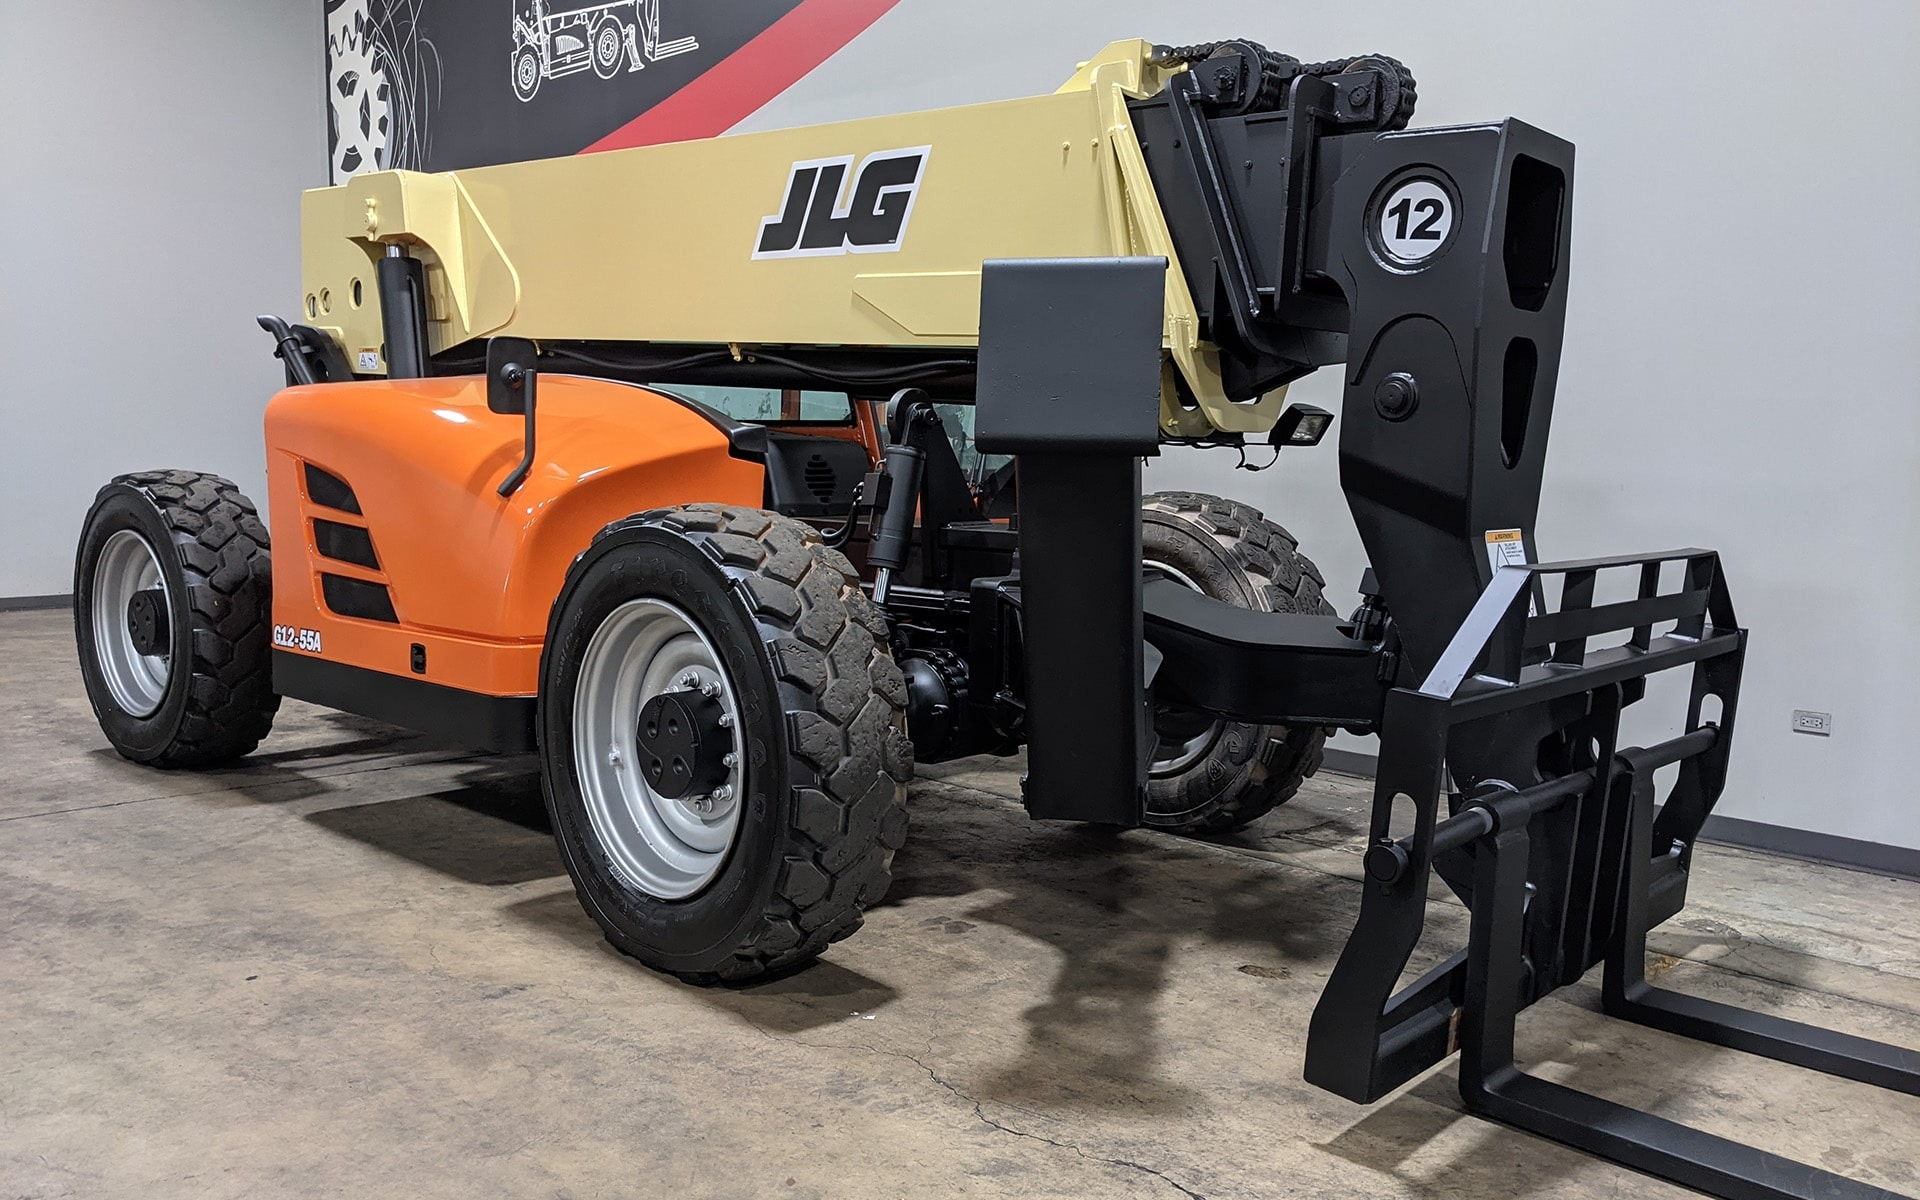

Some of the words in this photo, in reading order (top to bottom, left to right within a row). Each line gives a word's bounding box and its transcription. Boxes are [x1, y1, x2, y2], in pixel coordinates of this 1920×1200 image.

[757, 153, 923, 253] JLG
[1387, 198, 1445, 240] 12
[273, 624, 322, 652] G12-55A
